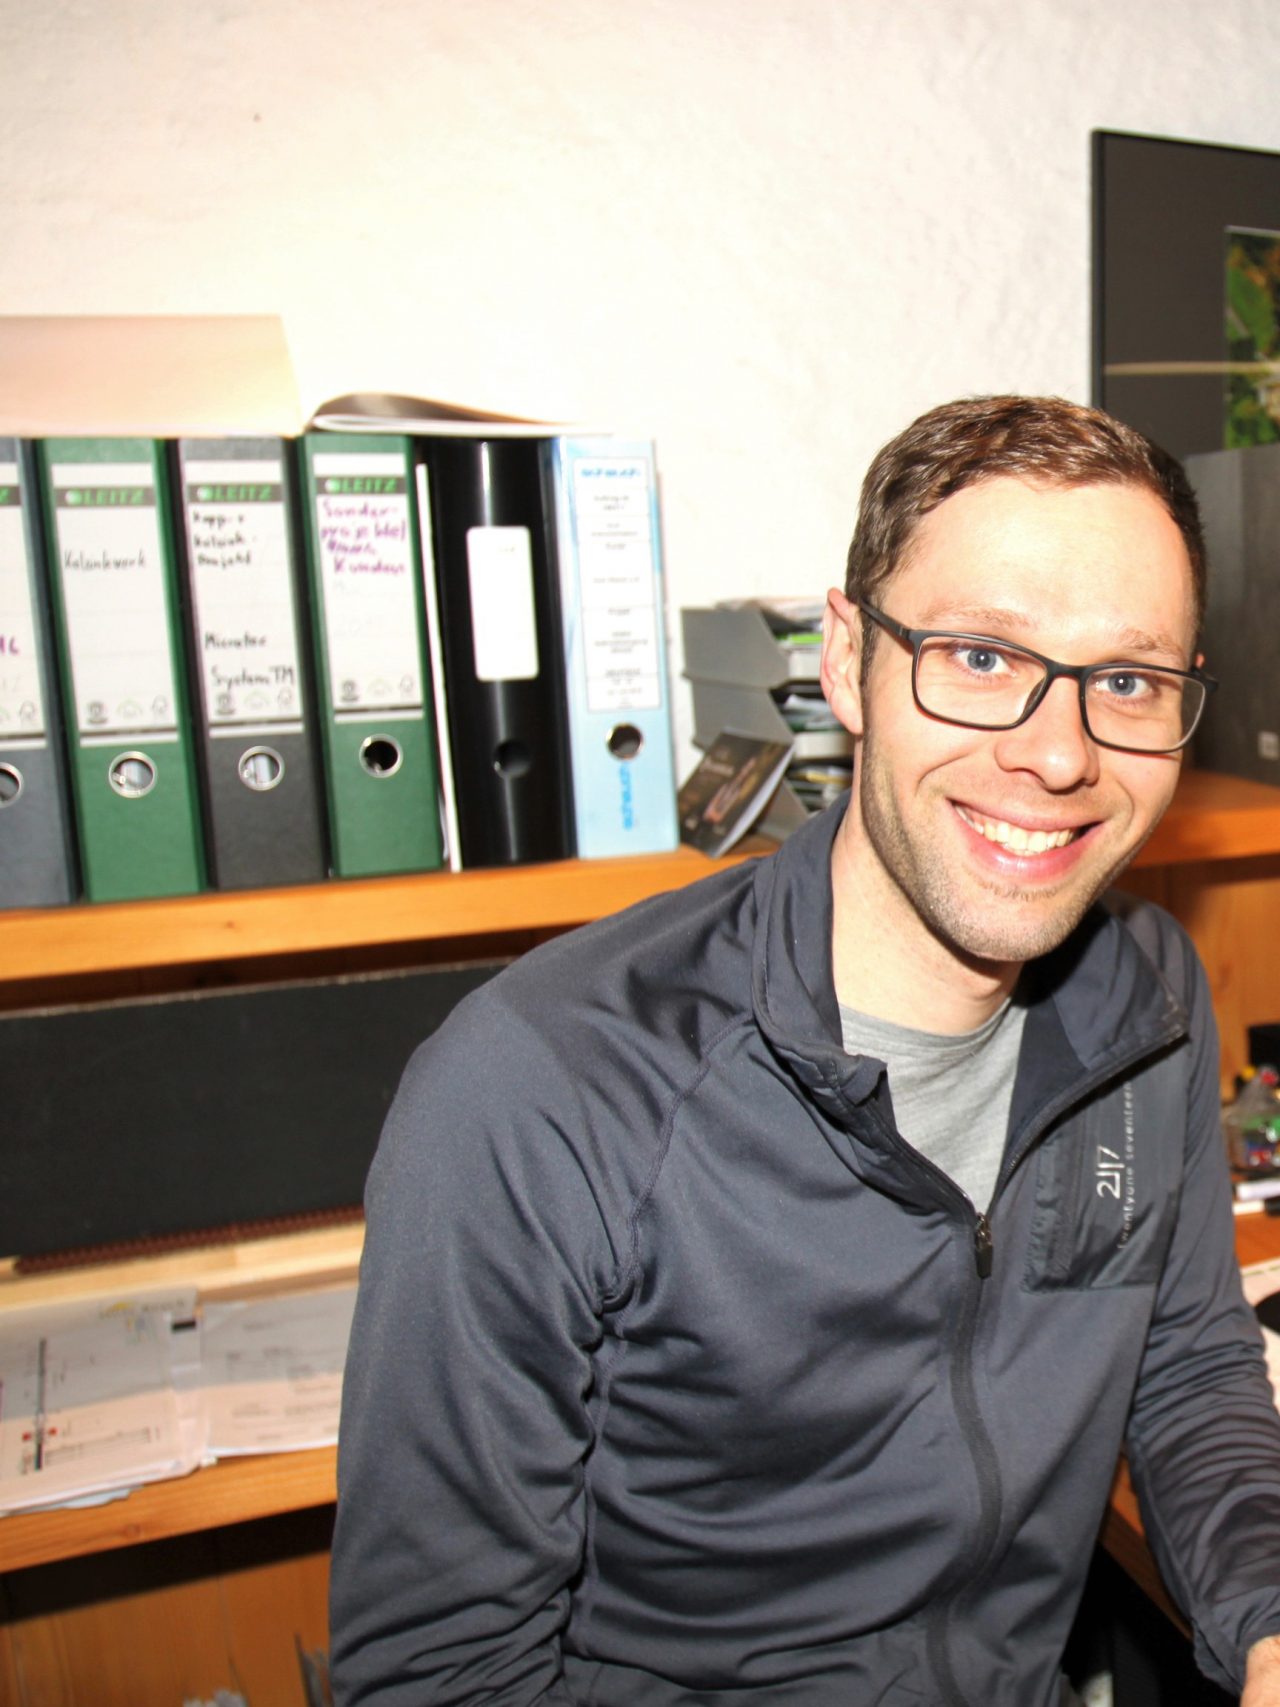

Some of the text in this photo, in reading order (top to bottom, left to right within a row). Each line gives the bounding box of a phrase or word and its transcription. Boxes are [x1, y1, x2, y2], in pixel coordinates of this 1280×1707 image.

[215, 484, 273, 503] LEITZ
[342, 478, 397, 494] LEITZ
[83, 488, 145, 505] LEITZ
